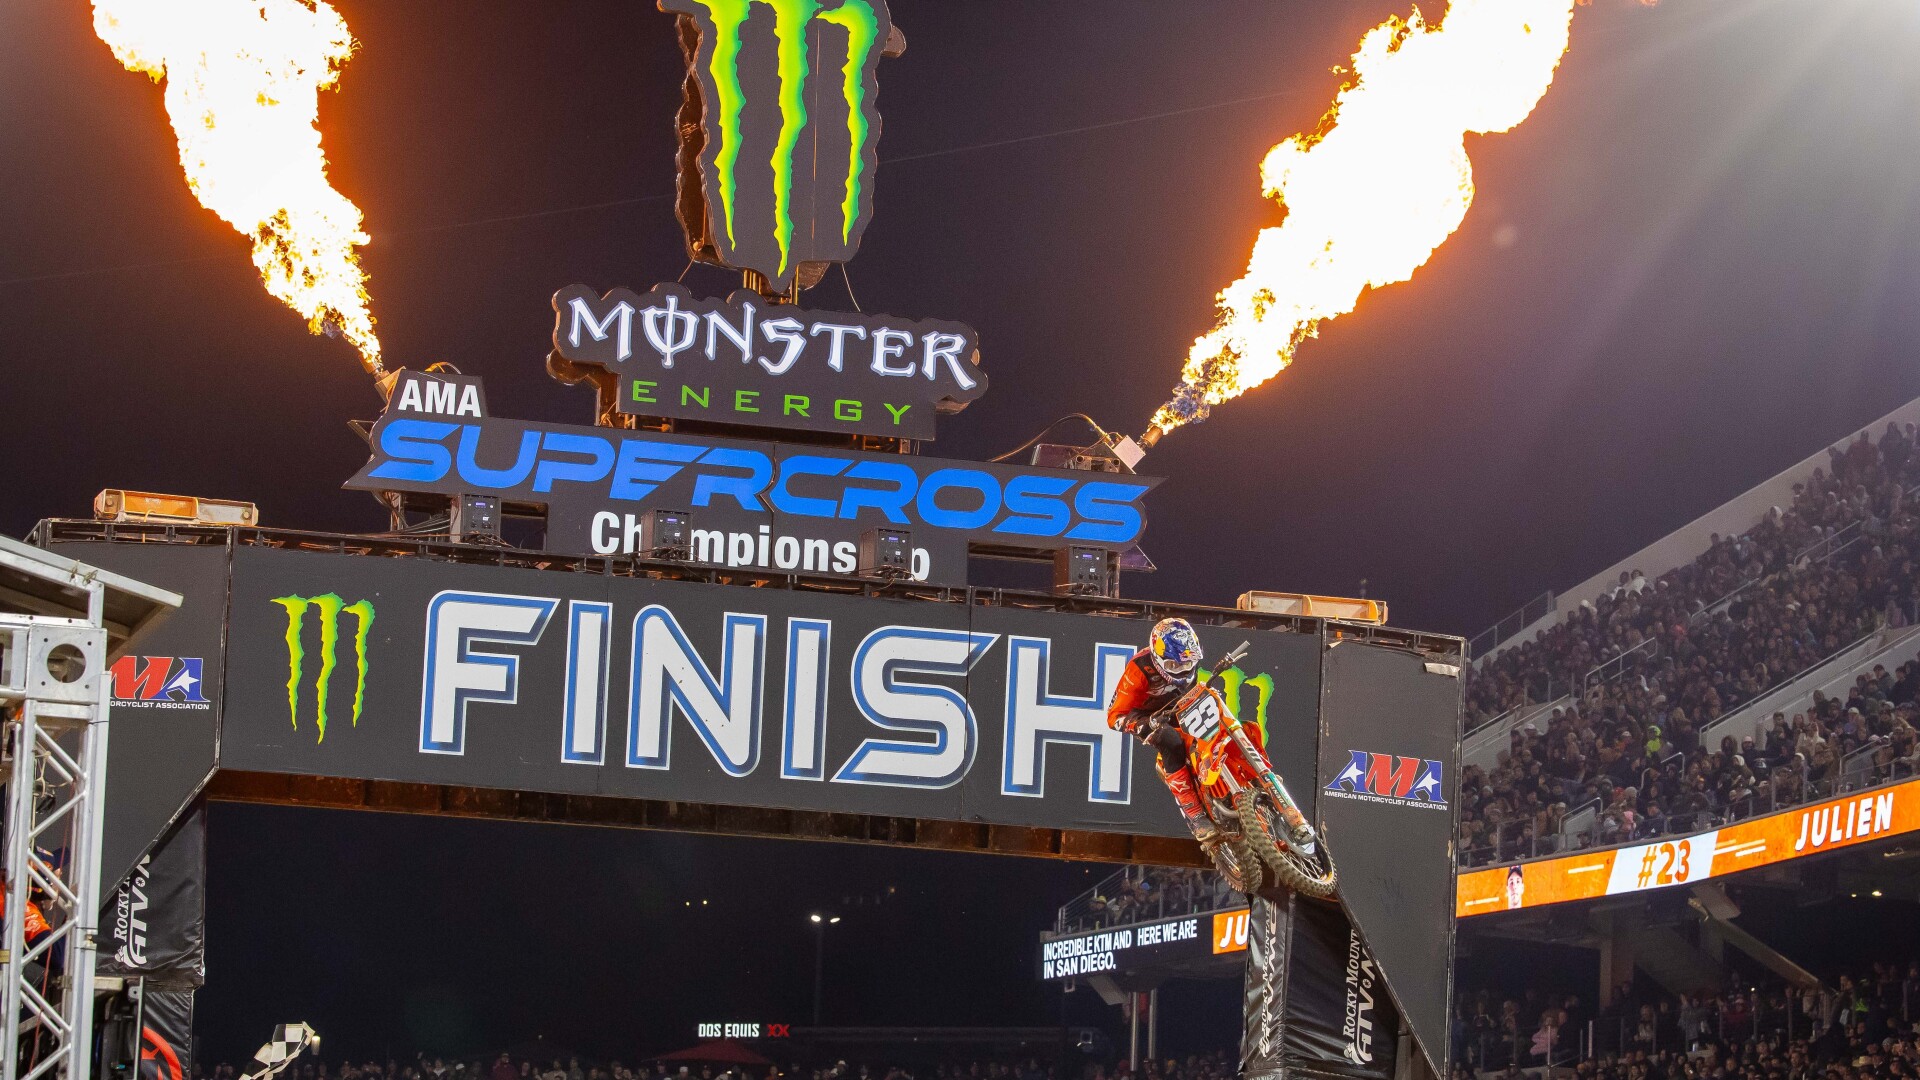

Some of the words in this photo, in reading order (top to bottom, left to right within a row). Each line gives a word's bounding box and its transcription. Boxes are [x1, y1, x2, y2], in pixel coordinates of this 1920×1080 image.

[569, 295, 976, 390] MONSTER
[398, 379, 482, 418] AMA
[632, 380, 911, 425] ENERGY
[367, 418, 1150, 543] SUPERCROSS
[591, 510, 931, 582] Chmpionsp
[110, 655, 211, 702] MA
[419, 589, 1139, 805] FINISH
[110, 700, 154, 708] ORCYCLIST
[155, 702, 210, 710] ASSOCIATION
[1184, 695, 1220, 739] 23
[1323, 750, 1448, 804] AMA
[1324, 790, 1357, 800] AMERICAN
[1358, 794, 1405, 806] MOTORCYCLIST
[1406, 801, 1448, 811] ASSOCIATION
[1795, 792, 1894, 851] JULIEN
[1637, 839, 1691, 888] #23
[114, 888, 129, 942] ROCKY
[1219, 913, 1250, 948] JU
[1043, 936, 1094, 961] INCREDIBLE
[1093, 933, 1113, 952] KTM
[1113, 930, 1133, 951] AND
[1137, 926, 1162, 947] HERE
[1162, 923, 1178, 942] WE
[1178, 919, 1198, 940] ARE
[1346, 929, 1361, 988] MOUNT
[1043, 961, 1054, 979] IN
[1056, 957, 1078, 977] SAN
[1080, 952, 1117, 975] DIEGO.
[698, 1023, 721, 1037] DOS
[725, 1023, 760, 1039] EQUIS
[767, 1023, 790, 1038] XX
[1343, 986, 1359, 1039] ROCKY
